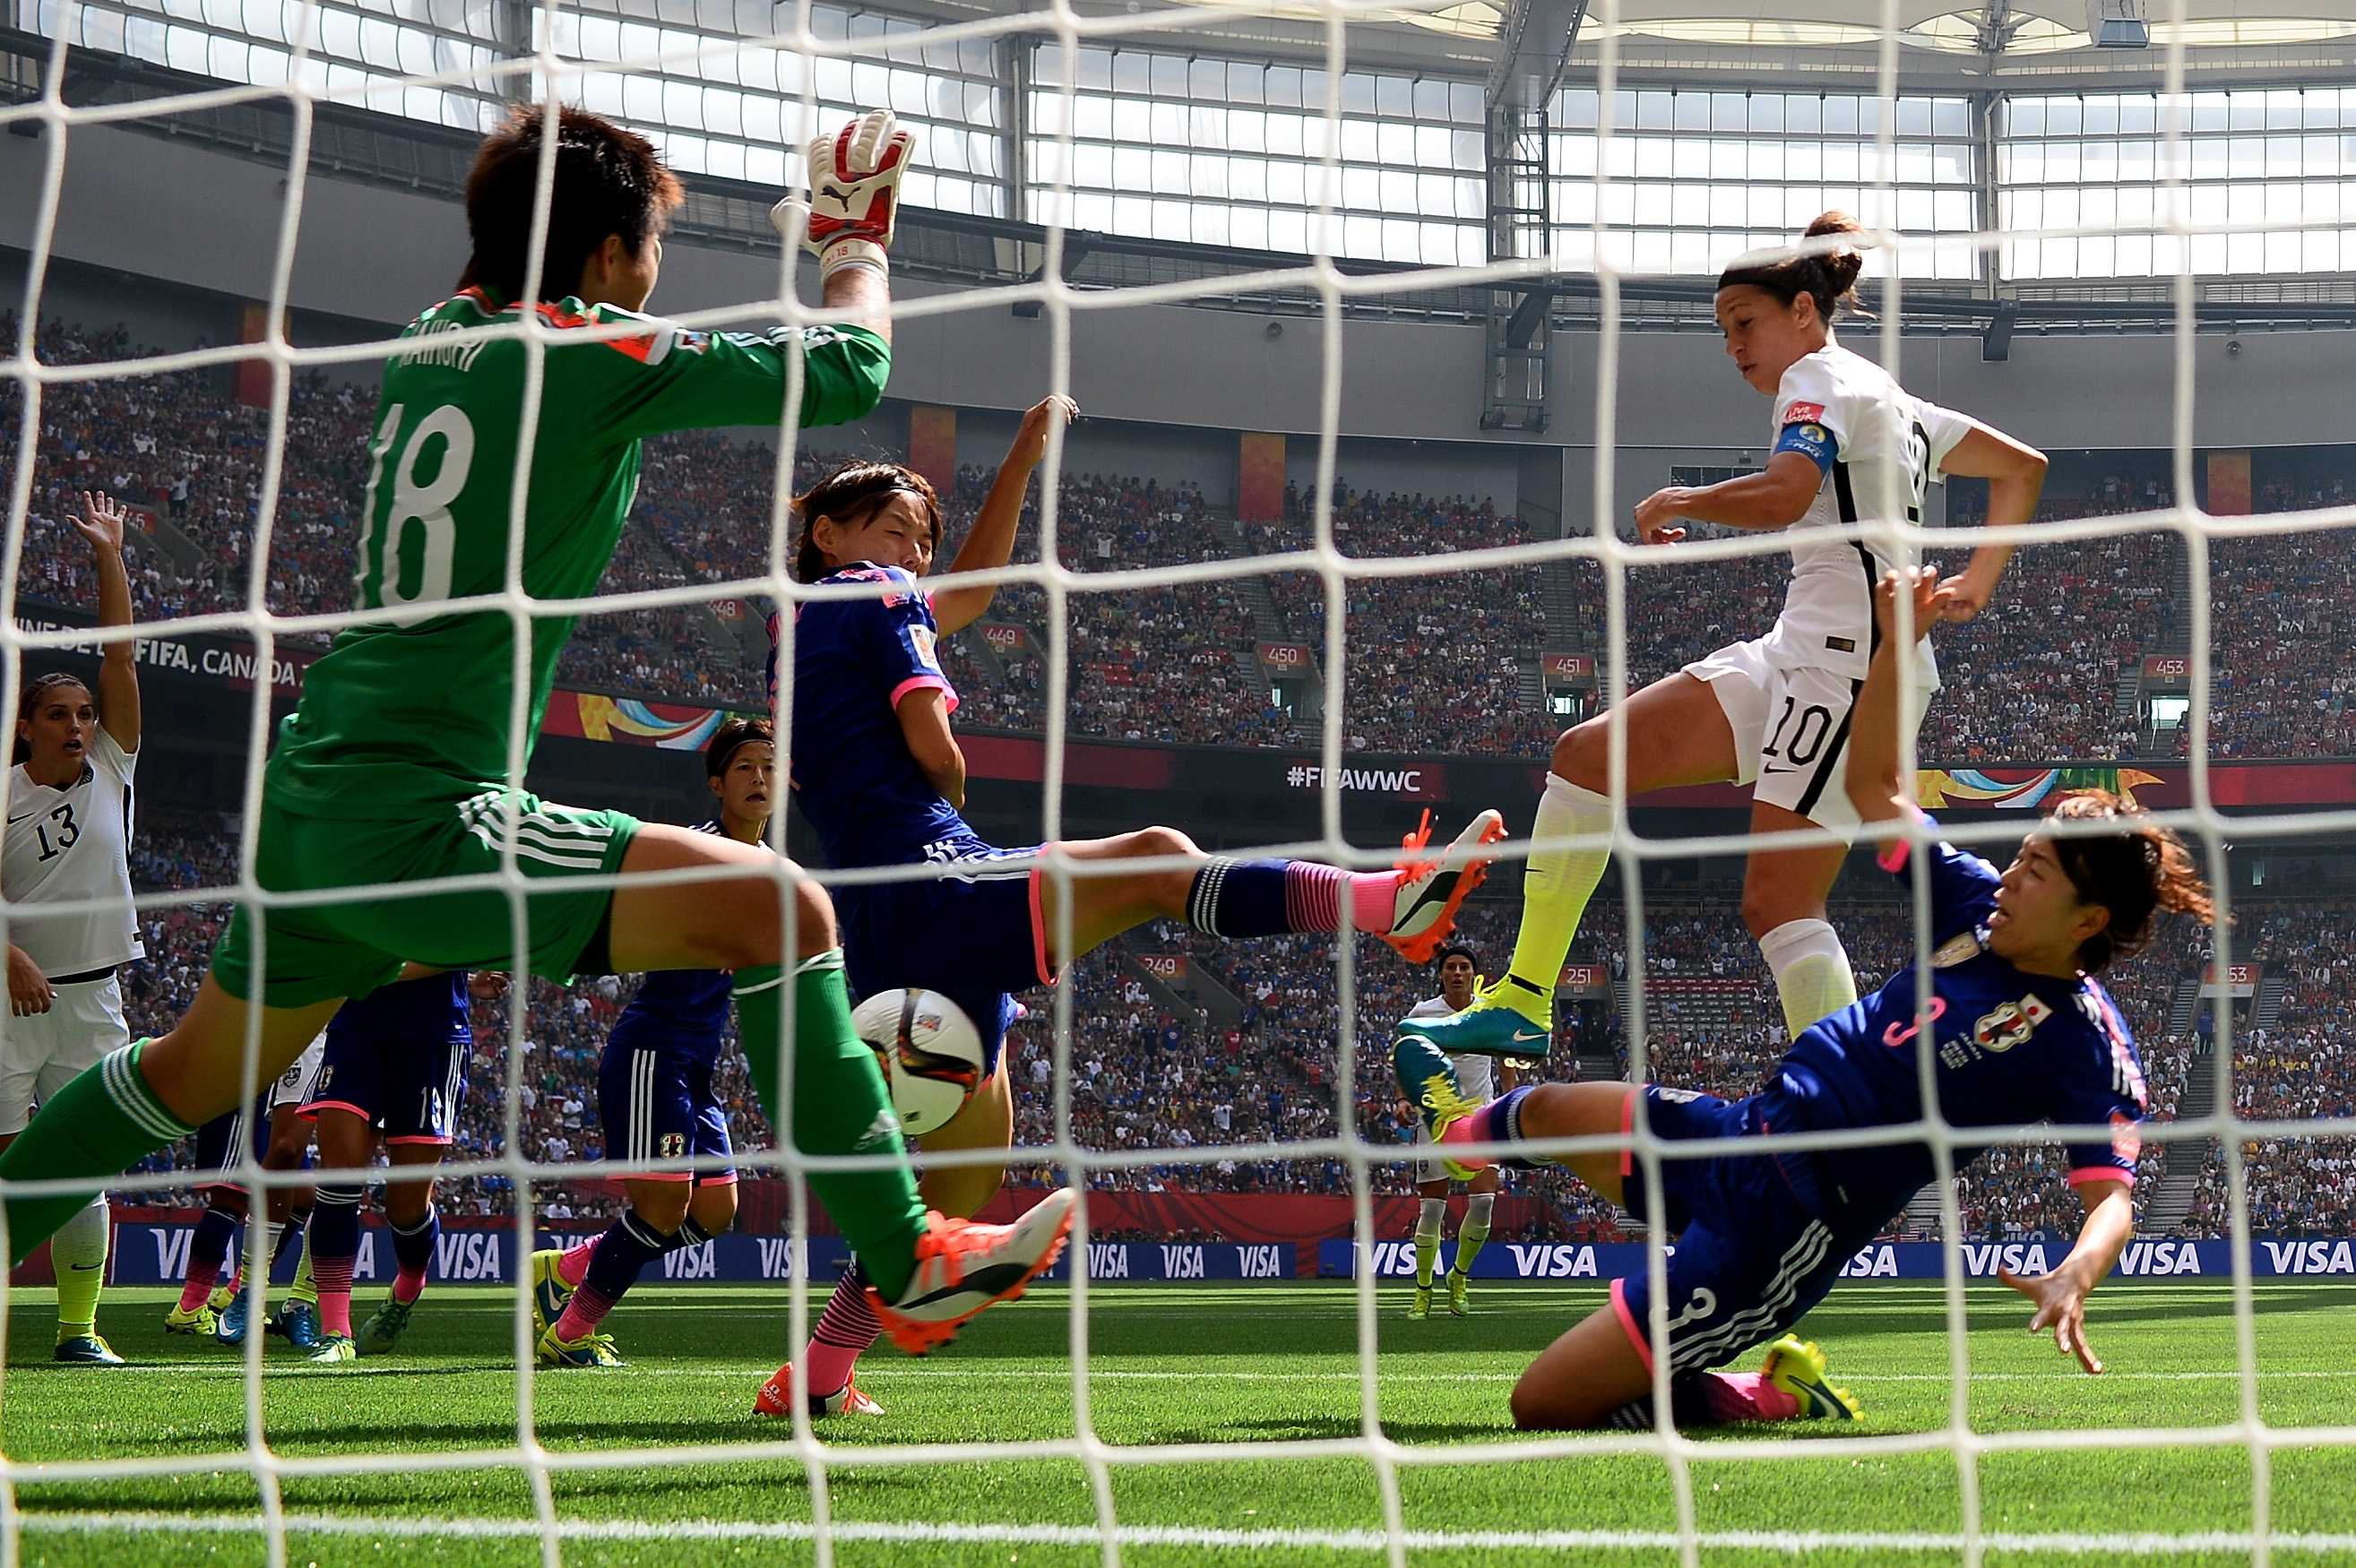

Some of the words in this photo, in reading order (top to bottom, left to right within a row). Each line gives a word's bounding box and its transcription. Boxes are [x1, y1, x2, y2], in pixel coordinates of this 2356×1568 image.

[353, 403, 475, 628] 18
[988, 628, 1015, 645] 449
[134, 637, 197, 674] FIFA,
[203, 649, 296, 686] CANADA
[1268, 647, 1298, 663] 450
[1556, 659, 1580, 673] 451
[2156, 660, 2184, 674] 453
[1762, 696, 1833, 766] 10
[1287, 766, 1421, 792] #FIAWWC
[36, 803, 80, 862] 13
[1144, 958, 1175, 975] 249
[1566, 969, 1591, 984] 251
[149, 1228, 235, 1279] VIA
[437, 1233, 500, 1279] VISA
[664, 1238, 715, 1279] VISA
[1086, 1244, 1128, 1278] VISA
[1161, 1245, 1204, 1278] VISA
[1237, 1245, 1281, 1277] VISA
[1506, 1245, 1598, 1276] VISA
[1844, 1245, 1898, 1277] SA
[1958, 1244, 2048, 1276] VISA
[2119, 1242, 2201, 1275] VISA
[2260, 1241, 2354, 1274] VISA
